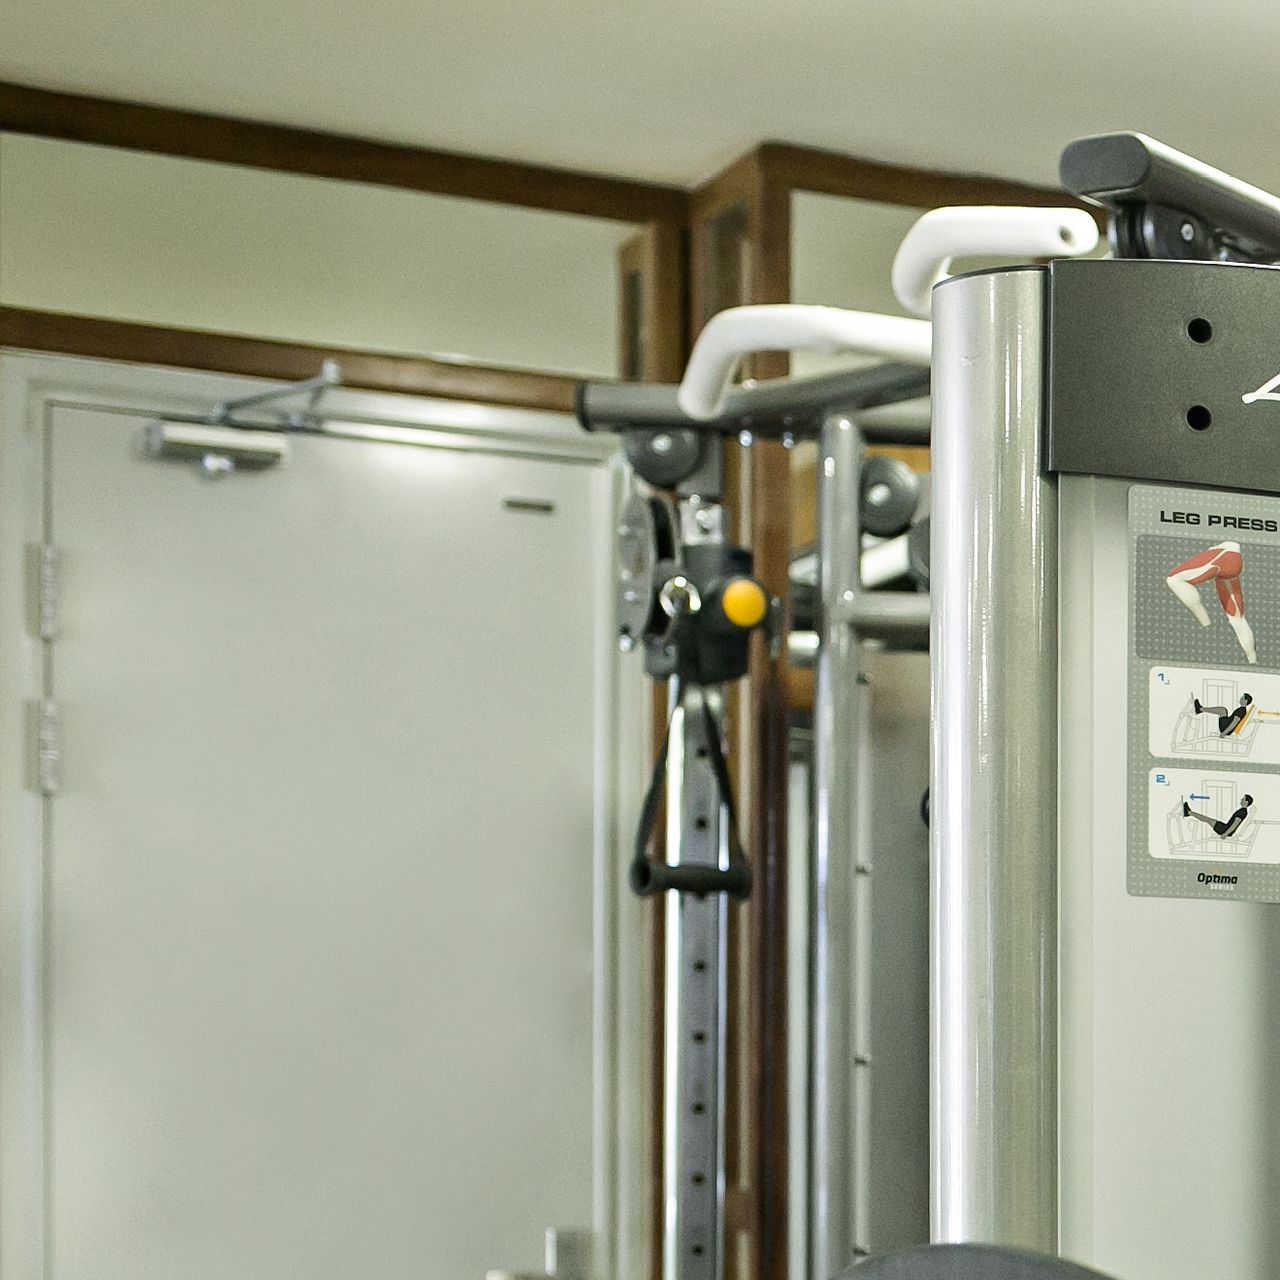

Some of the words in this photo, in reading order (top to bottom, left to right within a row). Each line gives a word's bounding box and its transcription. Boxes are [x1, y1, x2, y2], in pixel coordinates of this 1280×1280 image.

[1160, 511, 1201, 525] LEG
[1208, 515, 1278, 532] PRESS
[1156, 774, 1166, 783] 2
[1197, 872, 1238, 886] Optima
